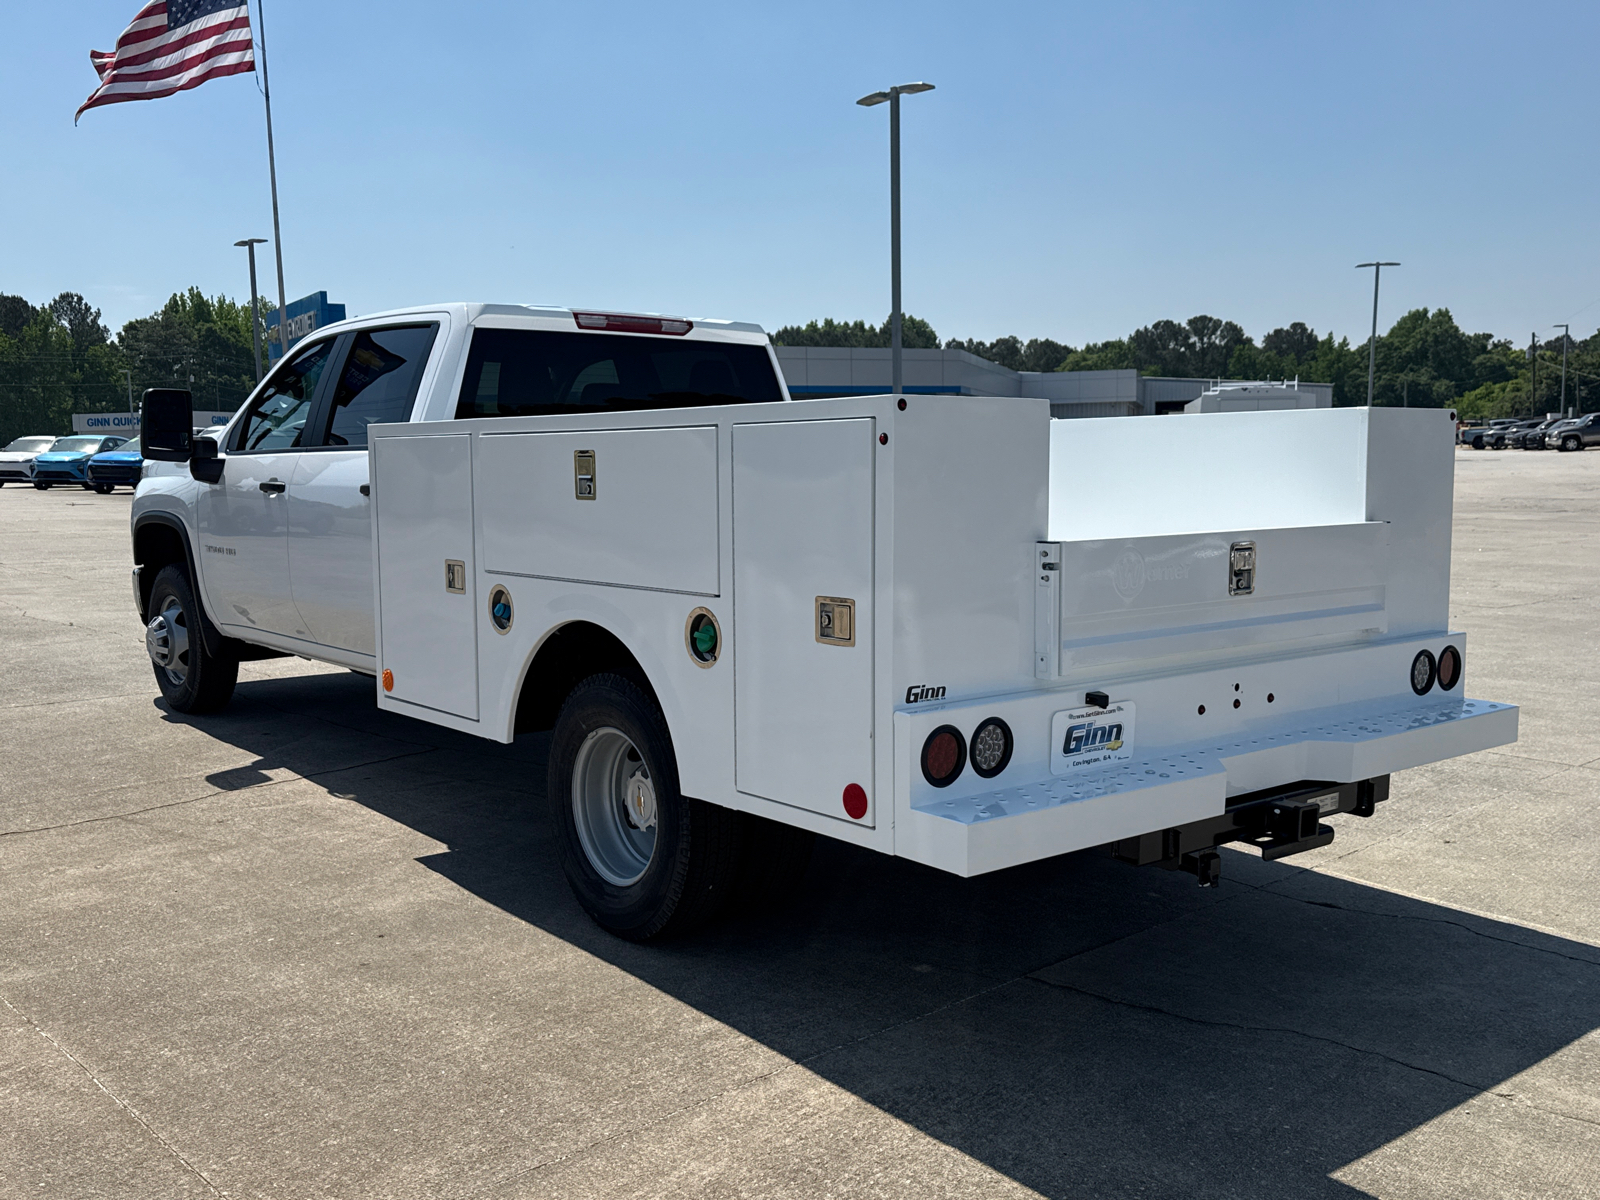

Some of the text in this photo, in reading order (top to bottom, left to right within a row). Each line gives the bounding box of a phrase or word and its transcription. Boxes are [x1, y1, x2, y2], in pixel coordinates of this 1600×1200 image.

[280, 310, 316, 342] EVROLET
[86, 417, 110, 427] GINN
[211, 415, 229, 425] GINN
[905, 684, 946, 704] Ginn
[1063, 722, 1123, 755] Ginn
